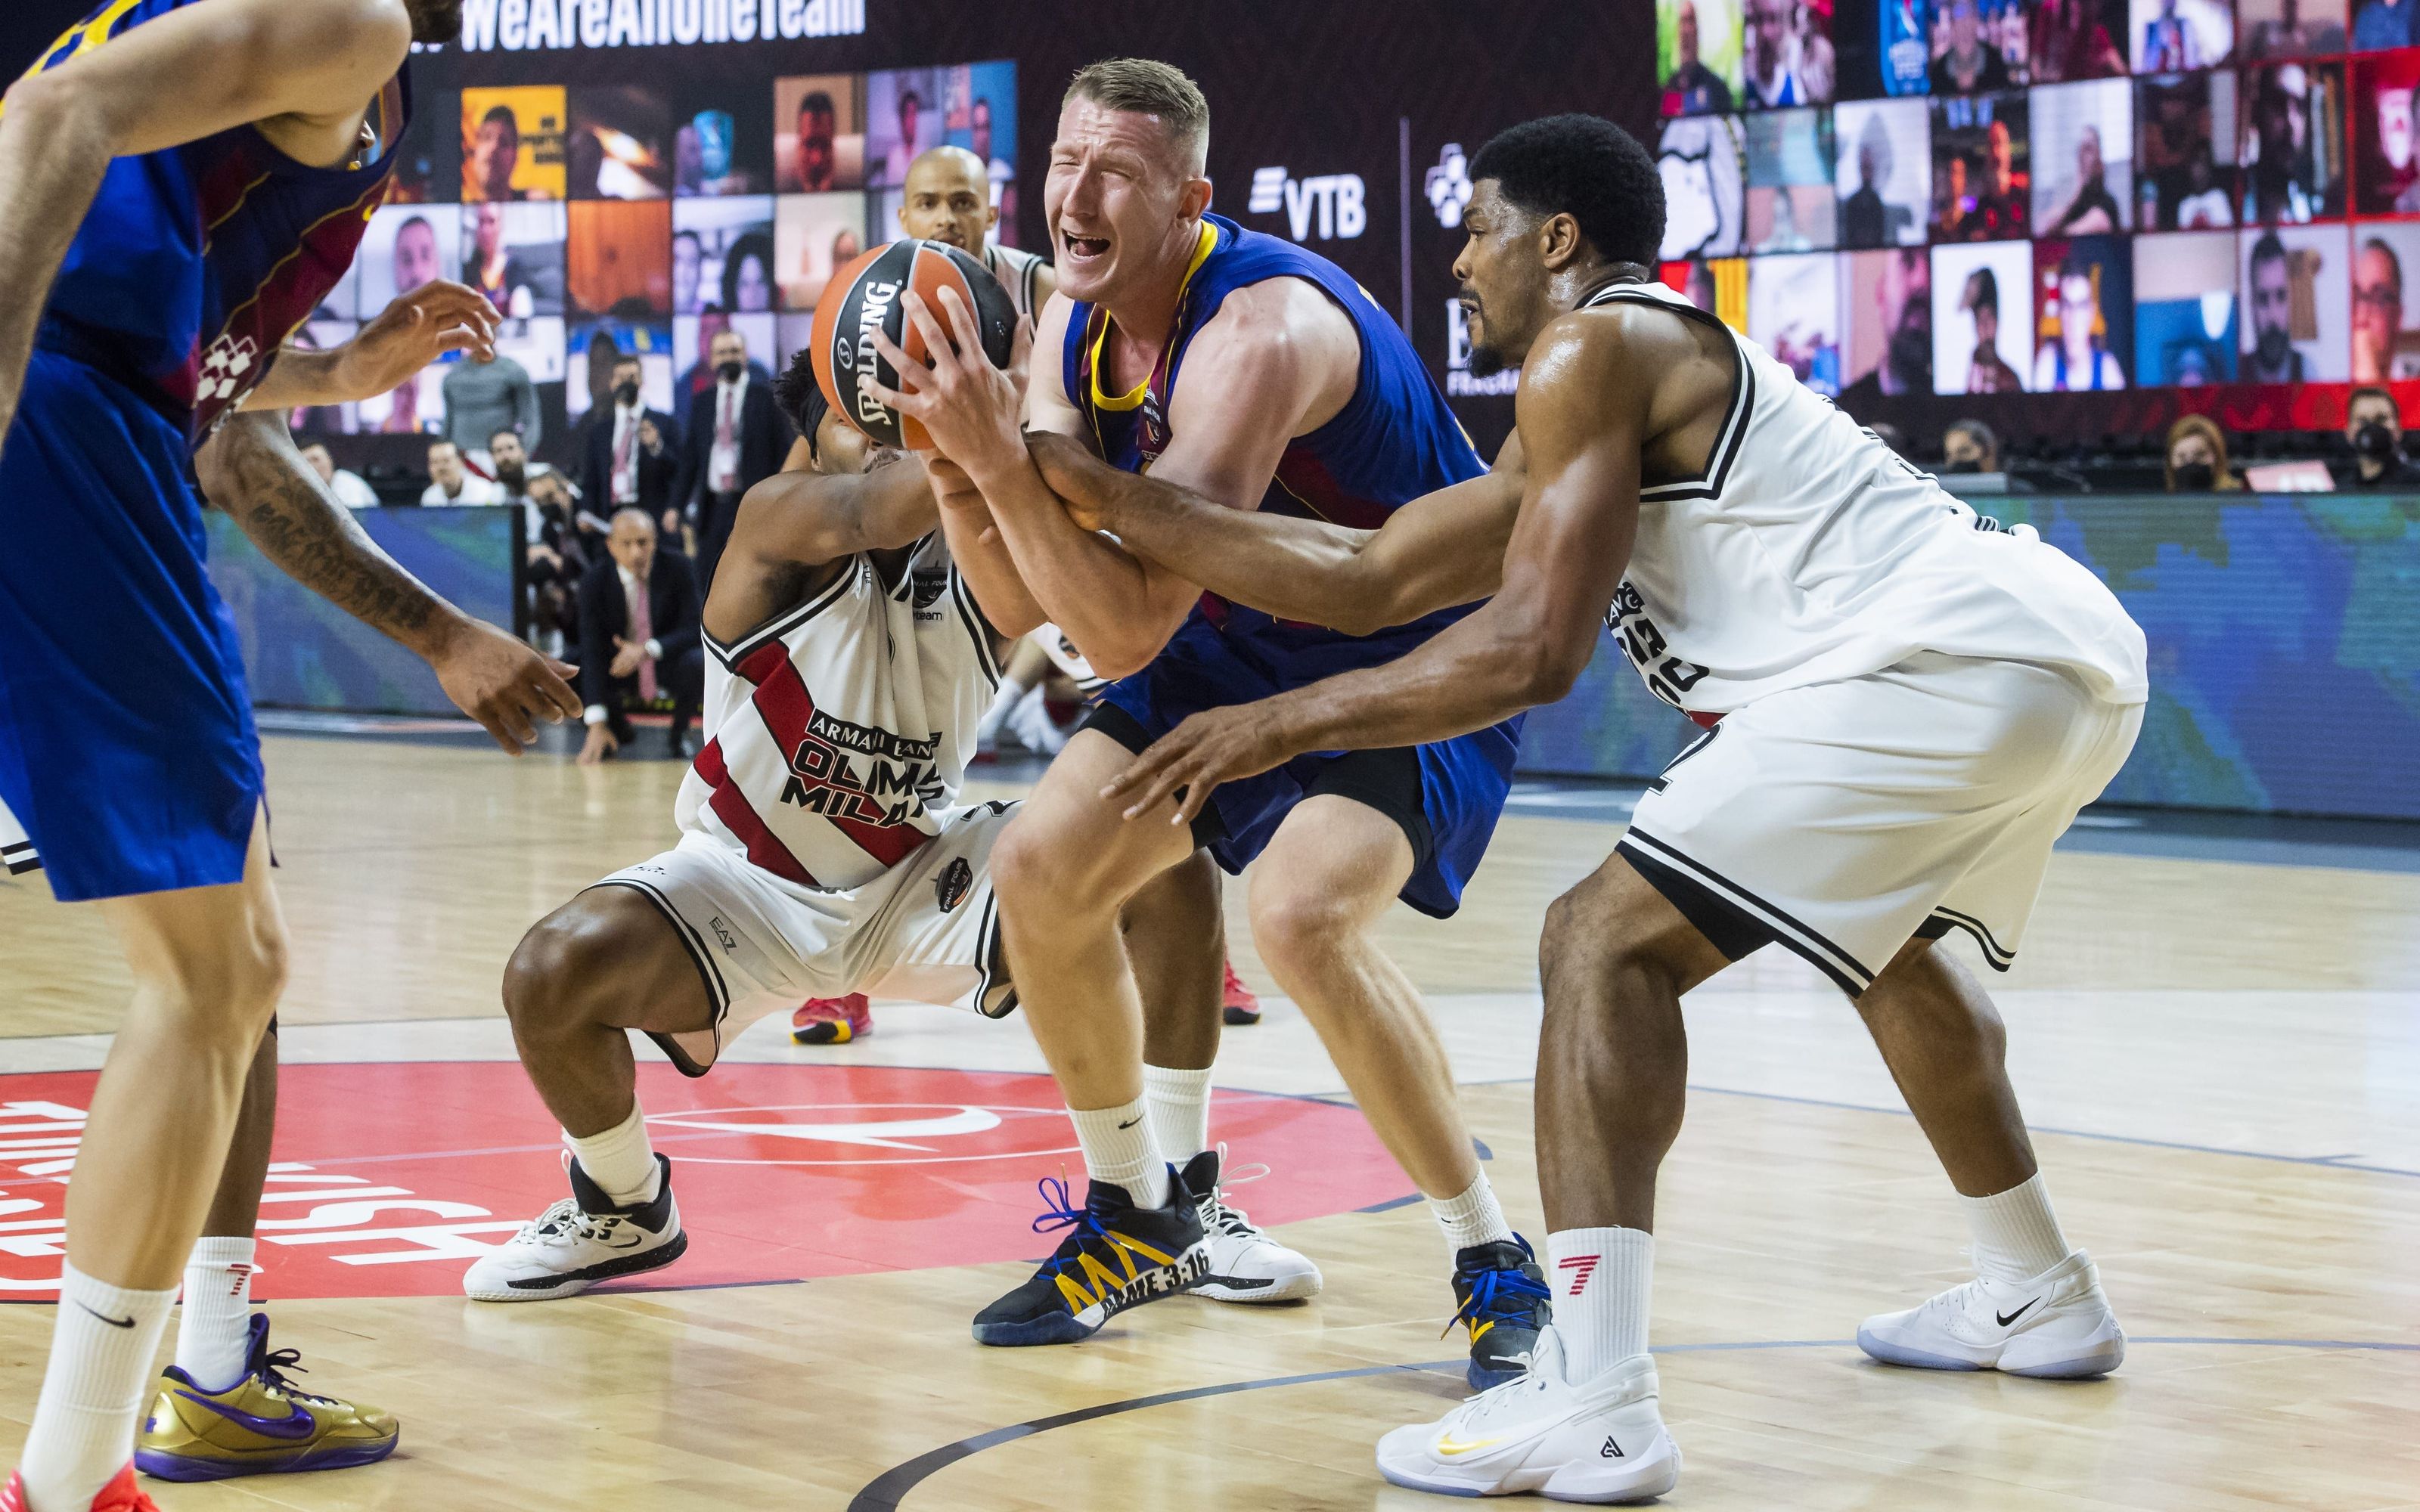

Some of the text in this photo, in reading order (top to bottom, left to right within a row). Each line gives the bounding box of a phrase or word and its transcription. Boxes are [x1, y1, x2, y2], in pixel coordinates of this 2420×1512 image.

[410, 0, 866, 53] WeAreAllOneTeam
[1285, 174, 1367, 241] VTB
[710, 916, 737, 949] EA7
